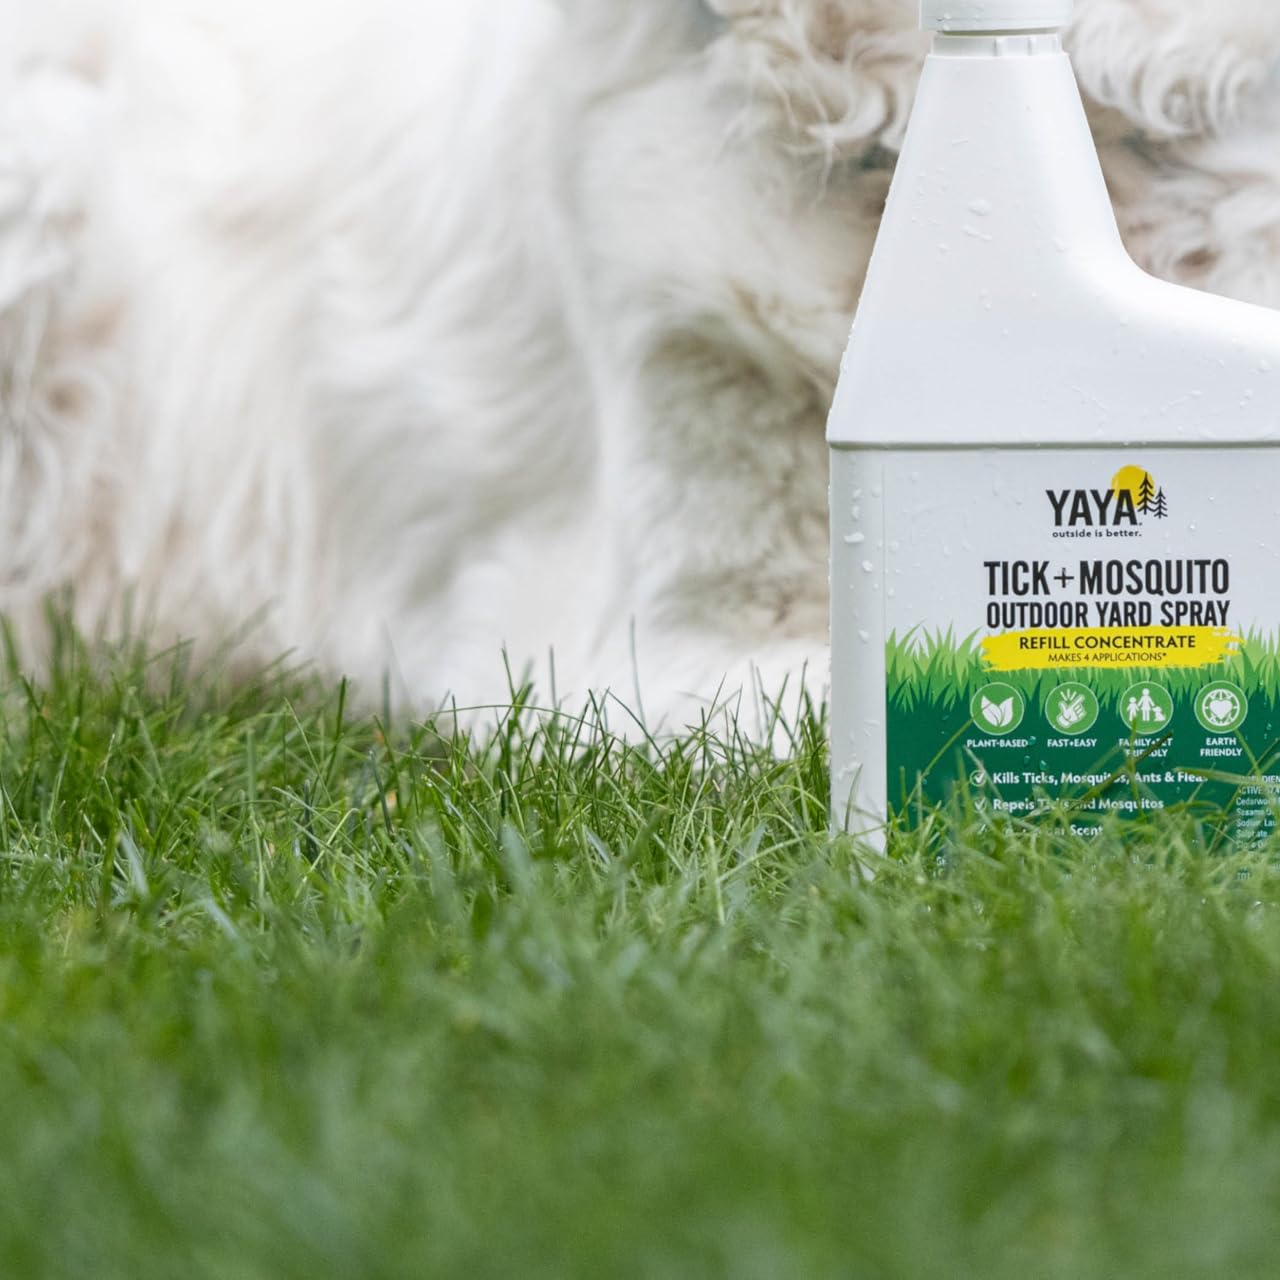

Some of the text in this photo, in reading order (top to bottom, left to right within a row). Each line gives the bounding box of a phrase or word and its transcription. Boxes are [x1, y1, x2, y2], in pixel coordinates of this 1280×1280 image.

[1052, 529, 1142, 538] outside is better.
[987, 600, 1230, 628] OUTDOOR YARD SPRAY
[1020, 635, 1196, 650] REFILL CONCENTRATE
[1048, 653, 1081, 663] MAKES
[1083, 654, 1090, 662] 4
[966, 739, 1028, 748] PLANT-BASED
[1206, 737, 1237, 746] EARTH
[1200, 748, 1243, 757] FRIENDLY
[993, 772, 1020, 784] Kills
[1022, 772, 1058, 786] Ticks,
[1135, 771, 1162, 783] Ants
[1164, 771, 1174, 782] &
